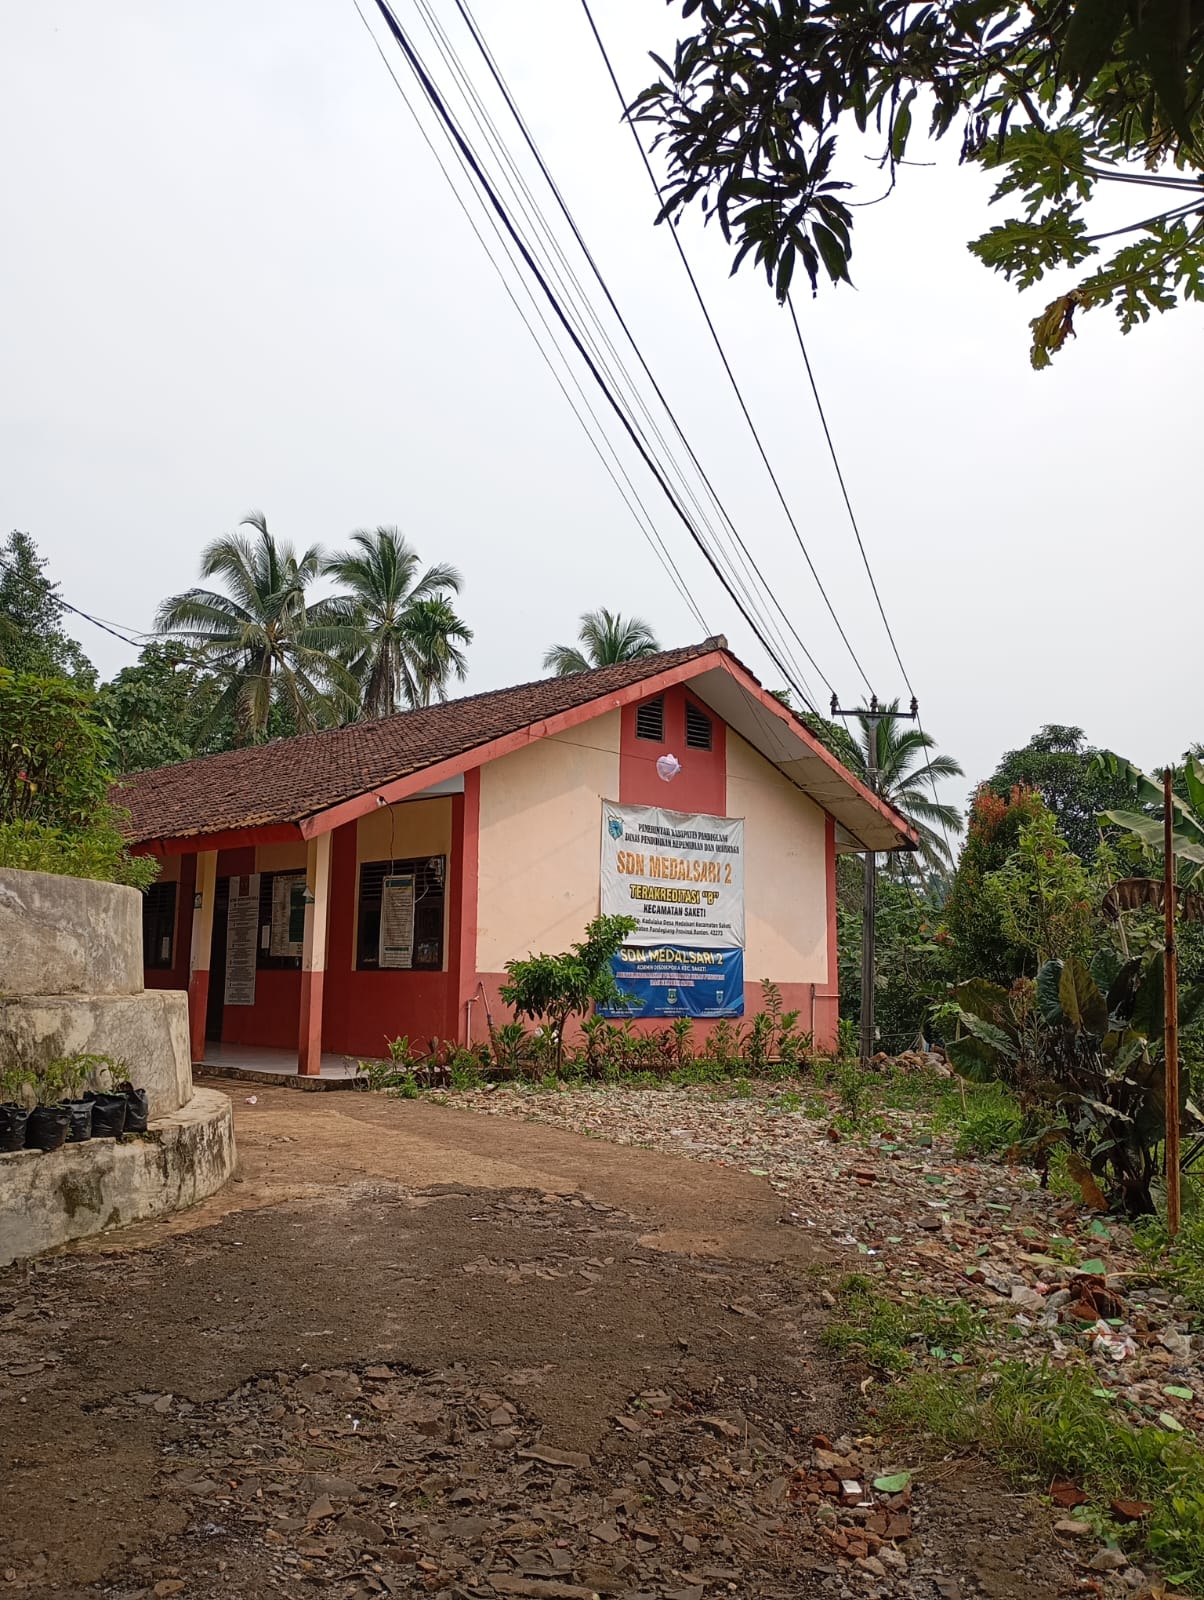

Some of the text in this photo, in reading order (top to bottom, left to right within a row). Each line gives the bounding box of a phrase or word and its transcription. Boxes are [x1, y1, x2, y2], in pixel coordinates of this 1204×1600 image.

[617, 850, 732, 884] SDN MEDALSARI 2
[630, 884, 700, 904] TERAKREDITASI
[644, 904, 706, 917] KECAMATAN SAKETI
[621, 948, 723, 965] SDN MEDALSARI 2
